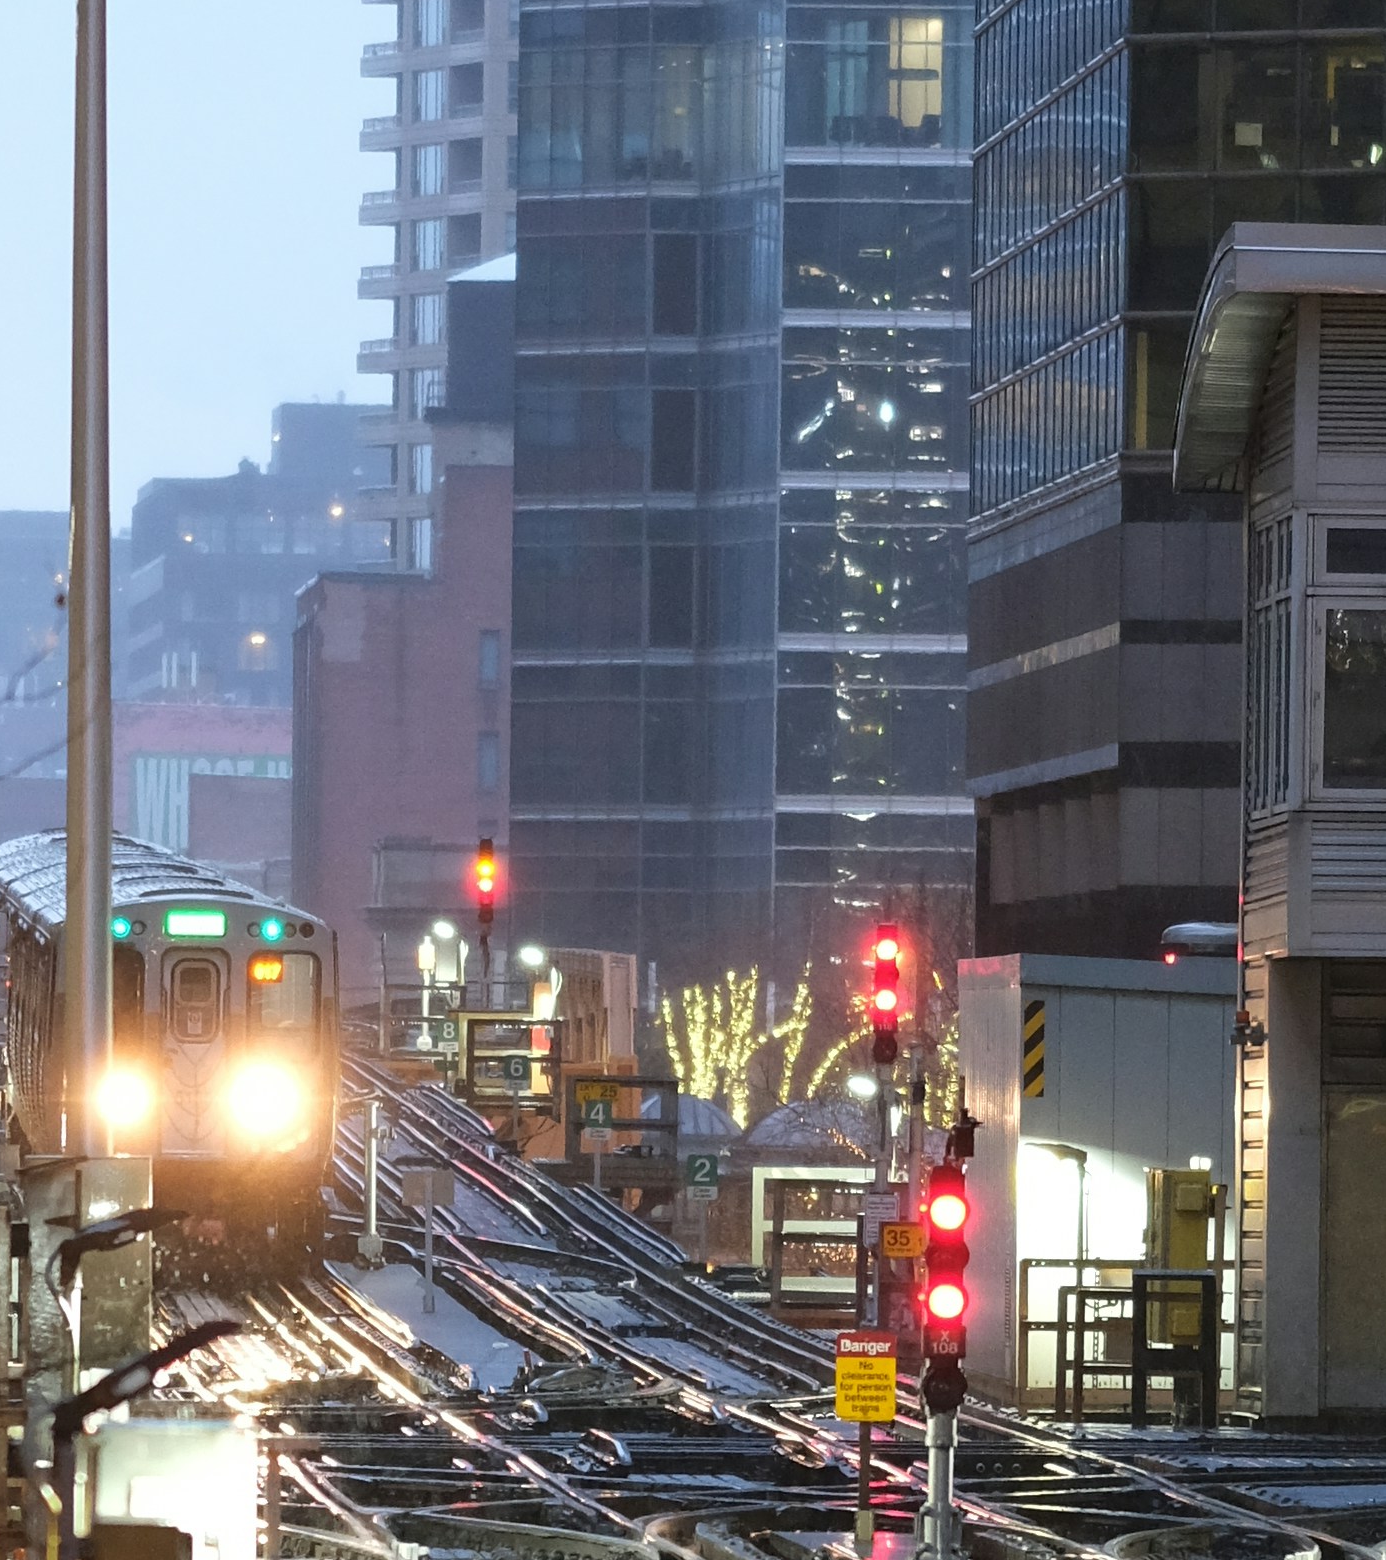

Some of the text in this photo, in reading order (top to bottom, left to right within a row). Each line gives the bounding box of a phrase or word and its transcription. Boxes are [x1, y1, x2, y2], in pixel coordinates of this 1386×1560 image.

[442, 1022, 455, 1038] 8
[510, 1058, 523, 1077] 6
[590, 1103, 606, 1124] 4
[694, 1158, 711, 1181] 2
[887, 1229, 910, 1246] 35
[941, 1330, 949, 1342] X
[840, 1339, 891, 1355] Danger
[932, 1342, 958, 1354] 108
[859, 1361, 874, 1370] No
[841, 1372, 890, 1380] clearance
[840, 1383, 892, 1393] for person
[844, 1393, 887, 1401] between
